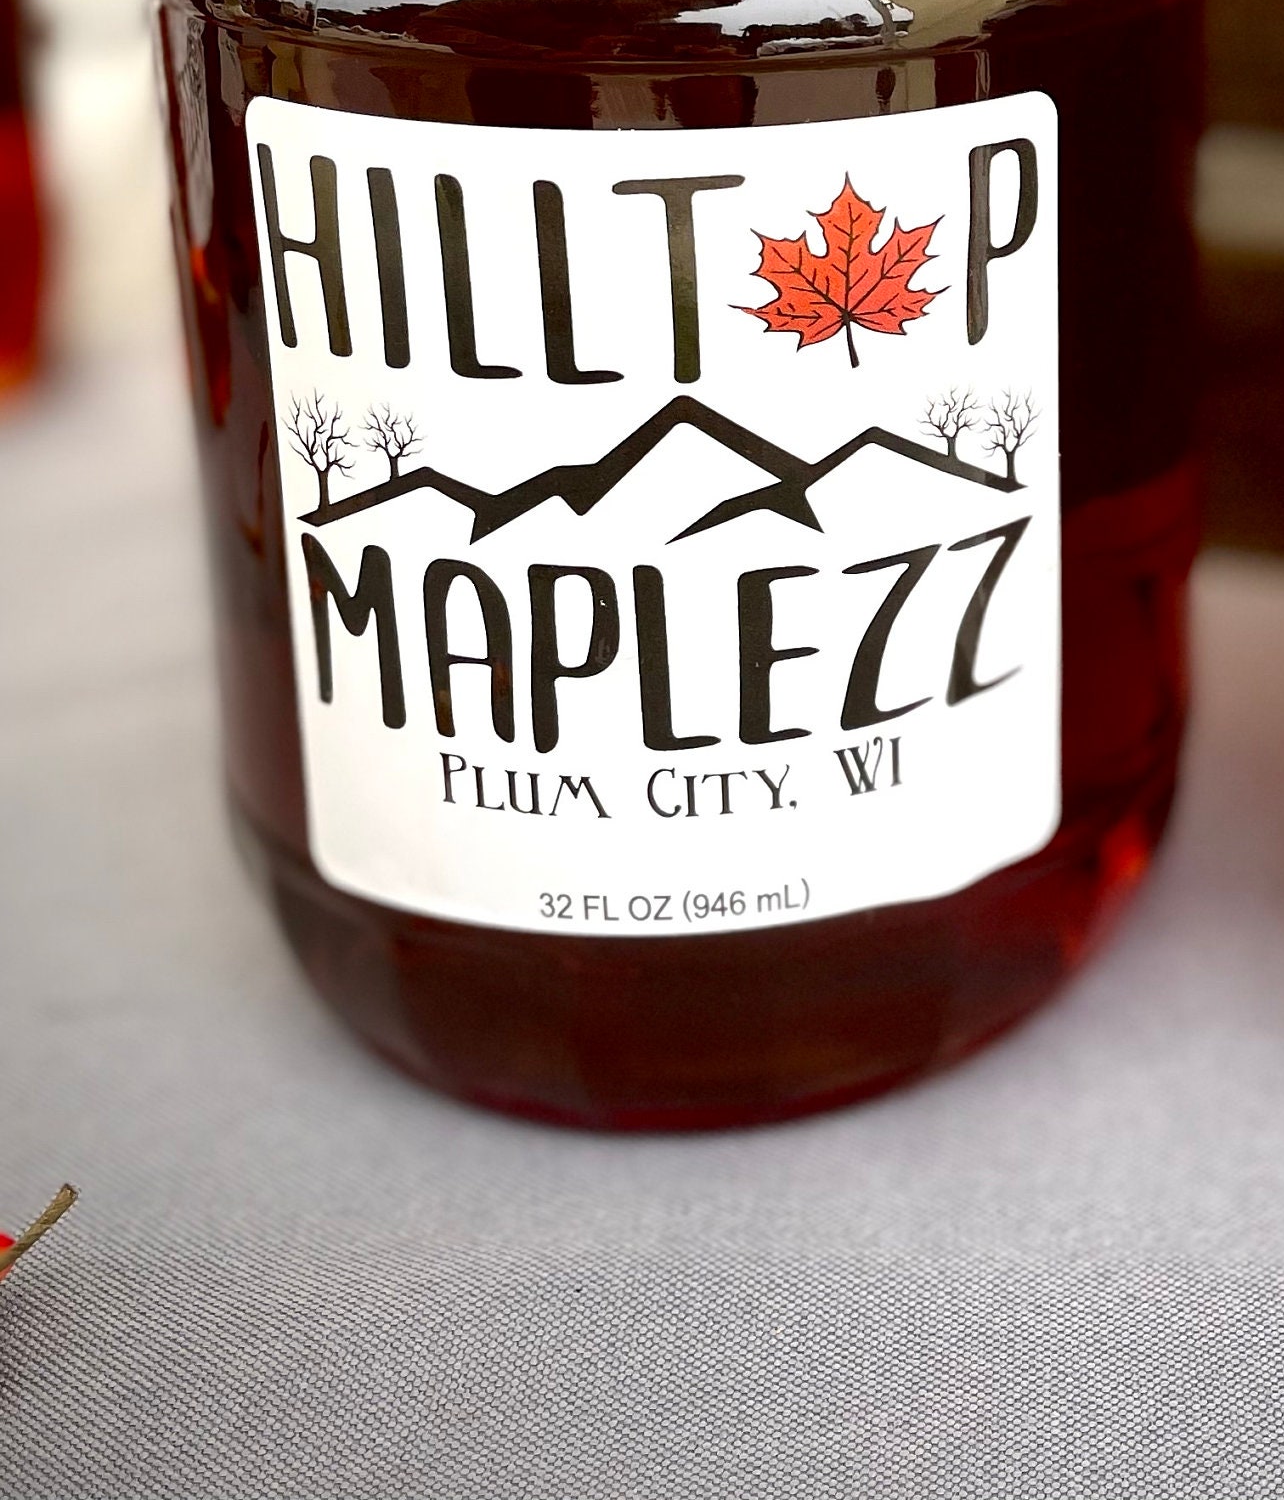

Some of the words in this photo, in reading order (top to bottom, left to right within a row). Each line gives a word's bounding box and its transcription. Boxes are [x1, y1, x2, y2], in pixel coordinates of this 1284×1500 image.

[300, 514, 1033, 754] MAPLEZZ
[440, 753, 611, 818] PLUM
[833, 737, 903, 796] WI
[540, 893, 572, 919] 32
[584, 896, 618, 920] FL
[629, 896, 672, 920] OZ
[683, 891, 745, 921] (946
[758, 879, 809, 912] mL)
